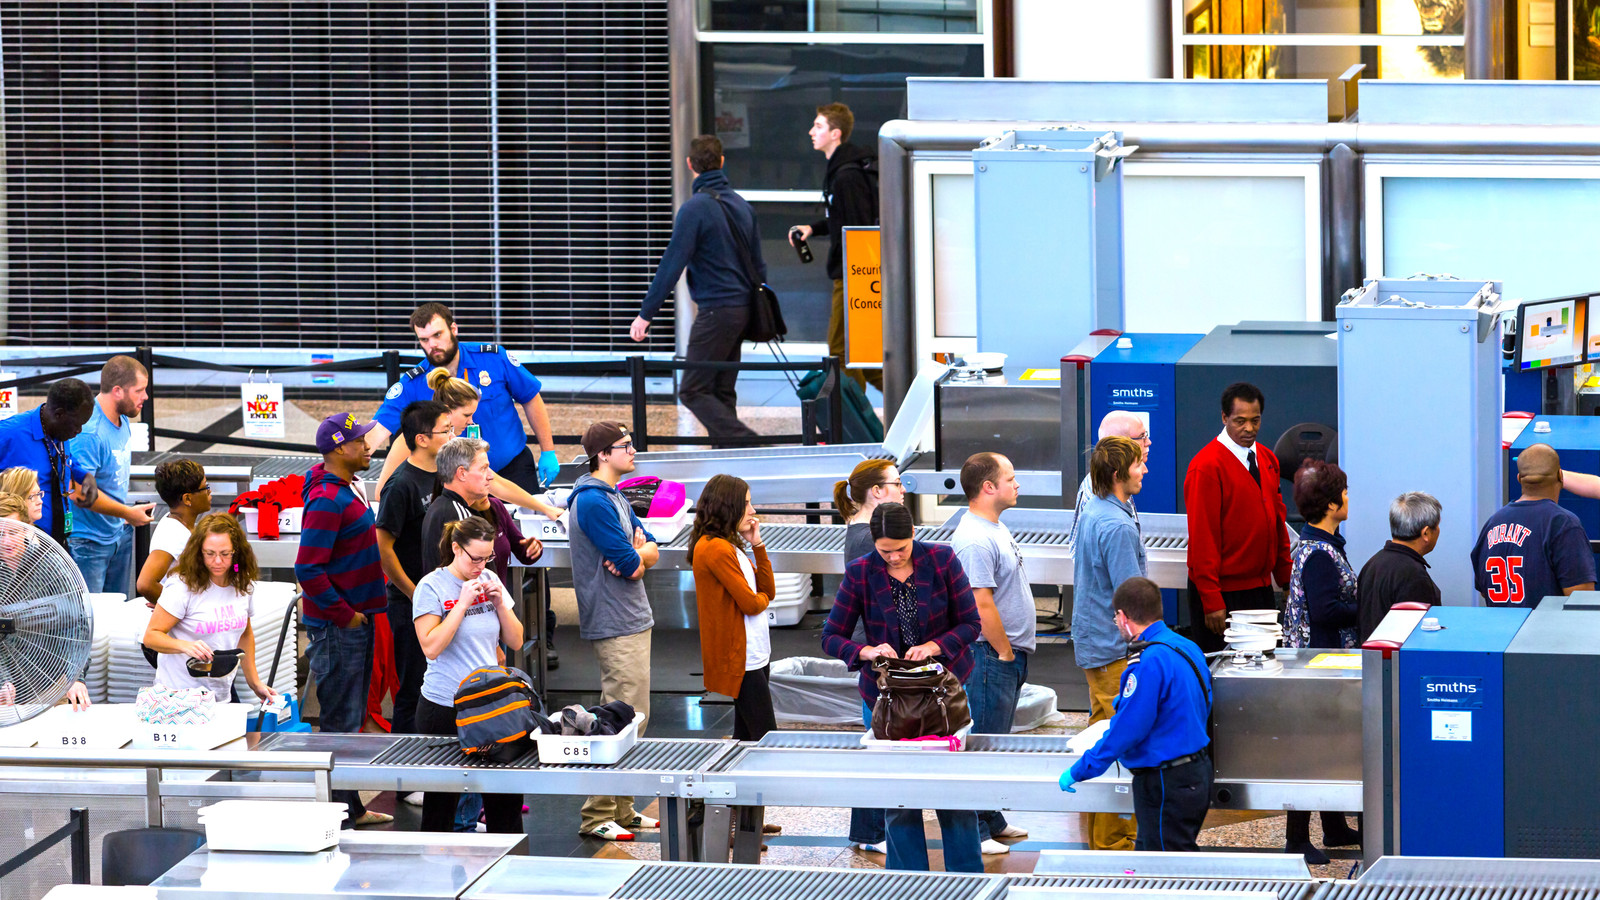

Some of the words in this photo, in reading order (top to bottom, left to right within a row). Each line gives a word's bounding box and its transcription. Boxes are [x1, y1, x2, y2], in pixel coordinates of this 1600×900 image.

[870, 280, 881, 294] C
[1112, 387, 1154, 398] smiths
[246, 401, 279, 412] NOT
[1487, 523, 1532, 550] DURANT
[1485, 555, 1526, 604] 35
[214, 607, 219, 620] I
[220, 604, 236, 619] AM
[1426, 682, 1477, 693] smiths
[62, 737, 87, 745] B38
[153, 733, 177, 743] B12
[563, 746, 589, 756] C85
